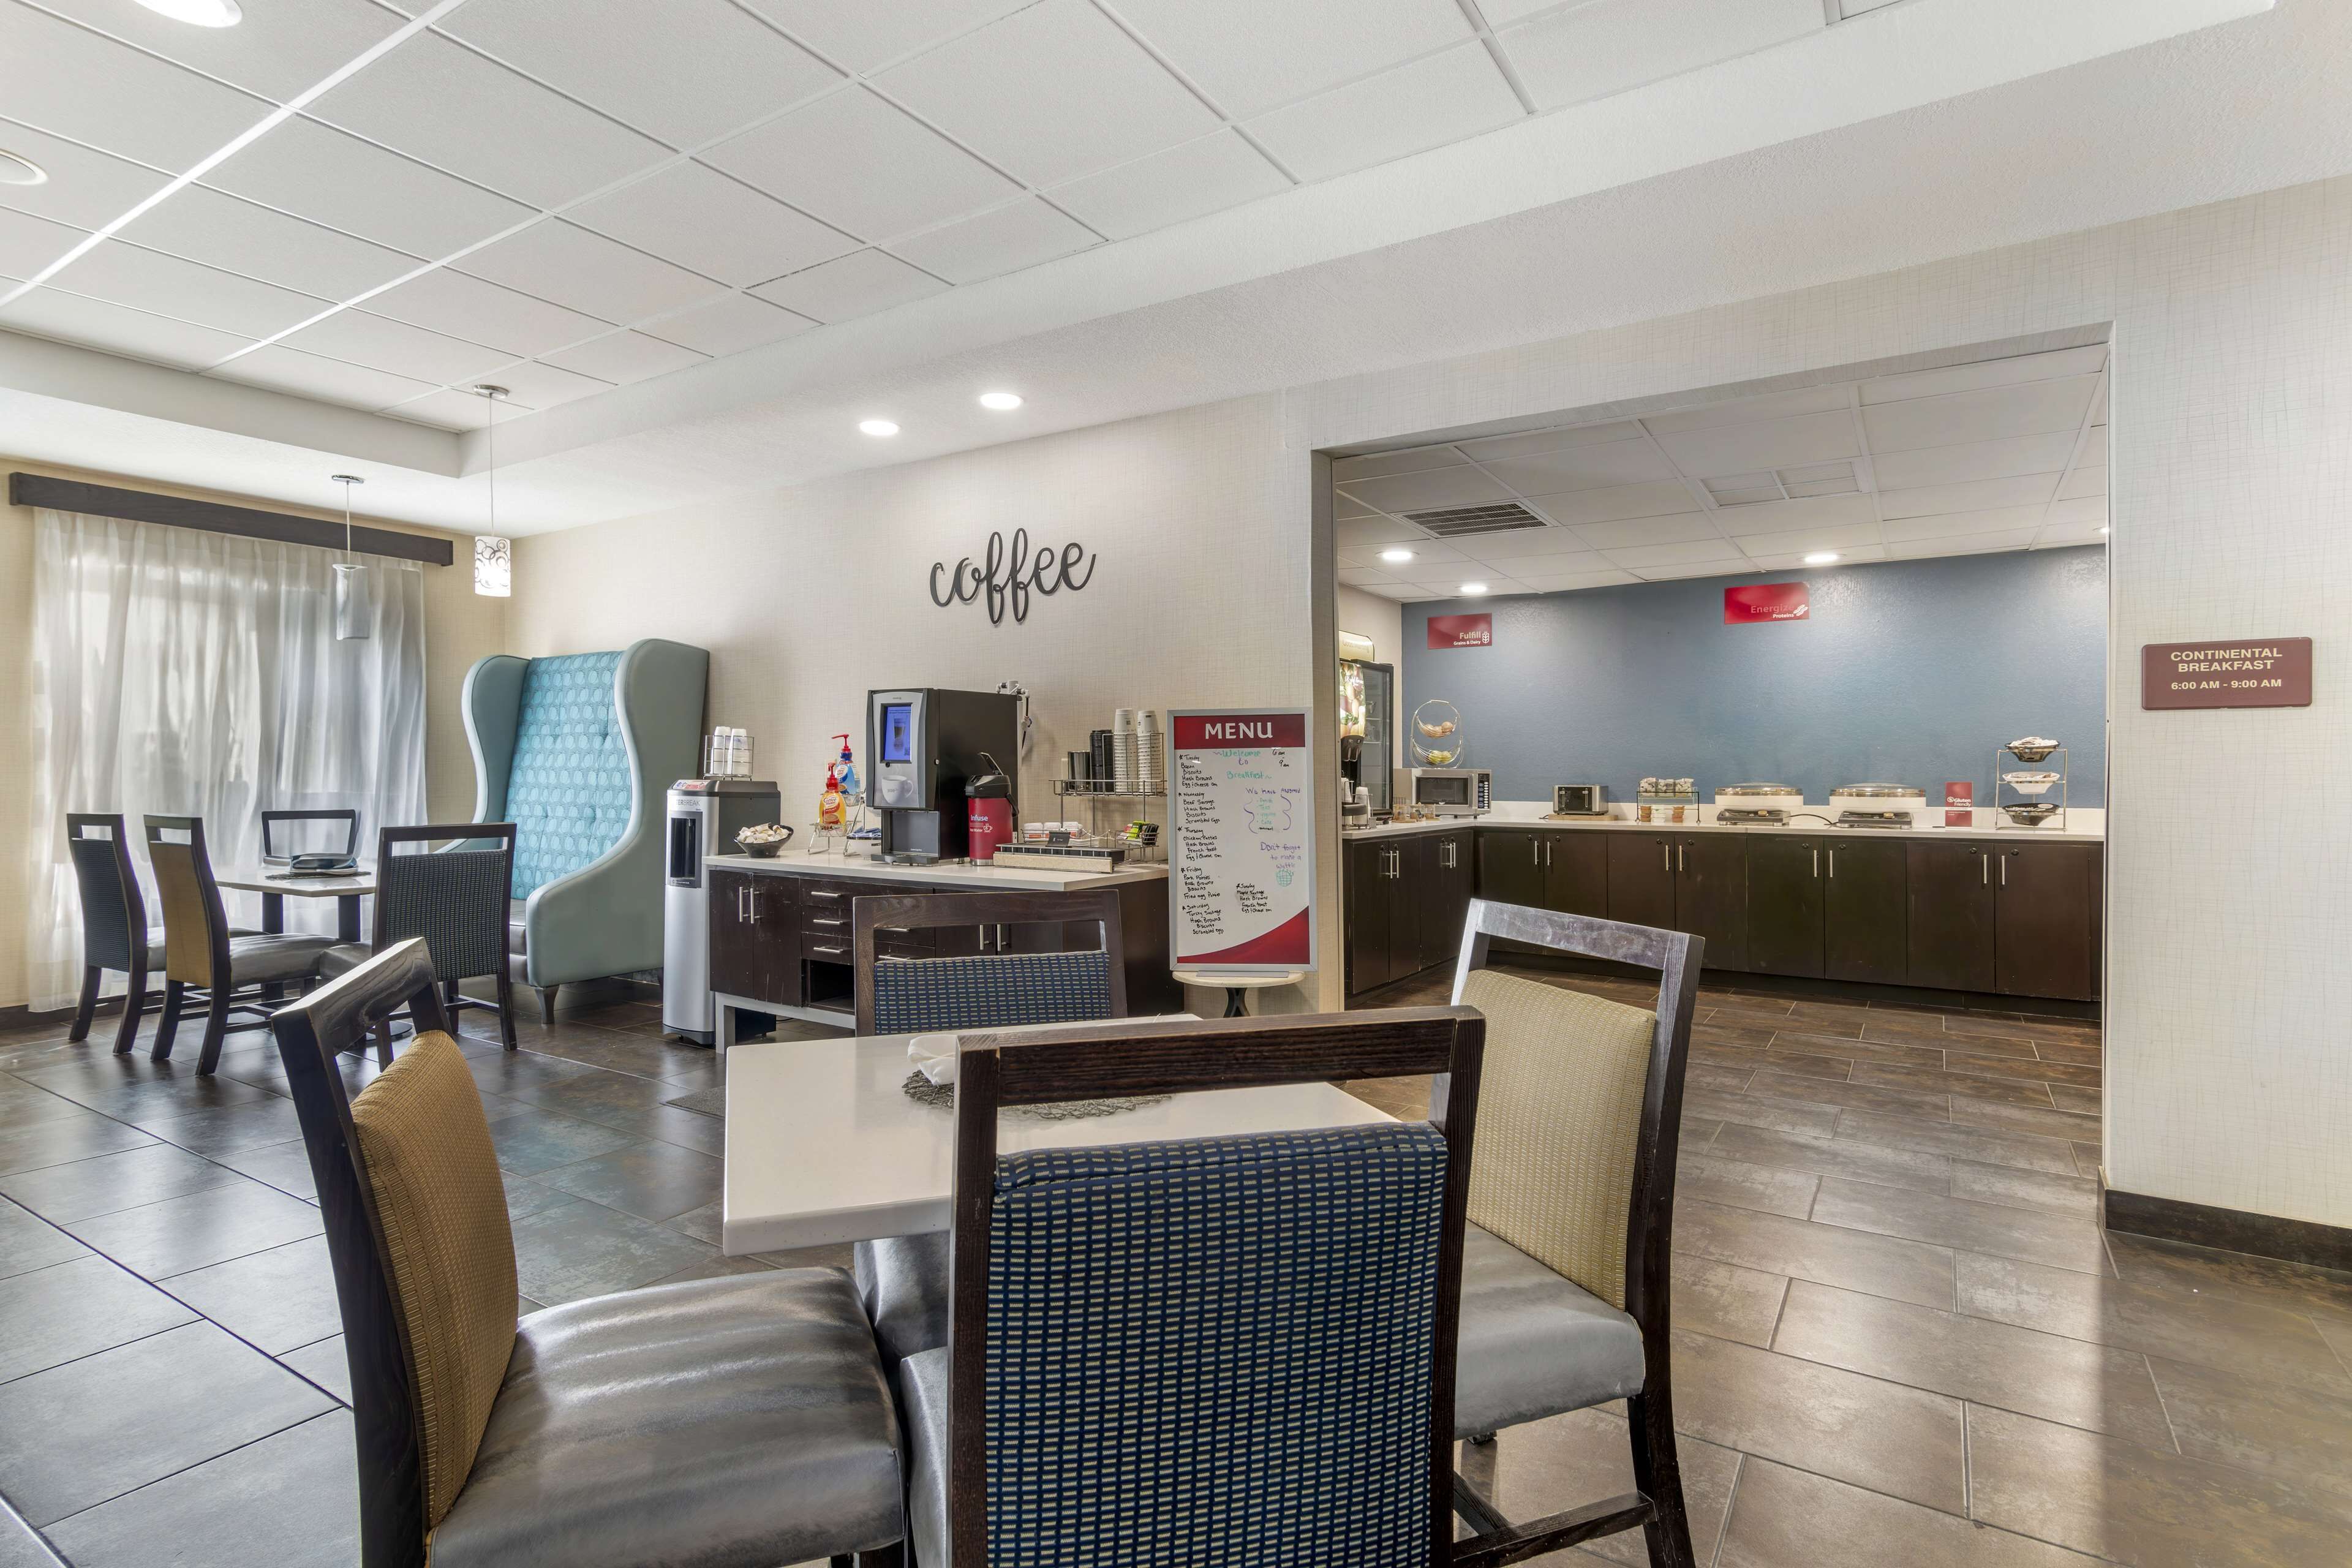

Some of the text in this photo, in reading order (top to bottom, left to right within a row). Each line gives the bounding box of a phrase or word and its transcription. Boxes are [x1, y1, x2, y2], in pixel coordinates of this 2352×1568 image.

[930, 528, 1096, 624] coffee
[1460, 631, 1481, 639] Fulfill
[2171, 647, 2283, 661] CONTINENTAL
[2178, 660, 2274, 672] BREAKFAST
[2171, 681, 2196, 690] 6:00
[2199, 680, 2220, 689] AM
[1205, 722, 1273, 739] MENU
[1186, 866, 1202, 876] Friday
[1240, 883, 1254, 892] Sunday
